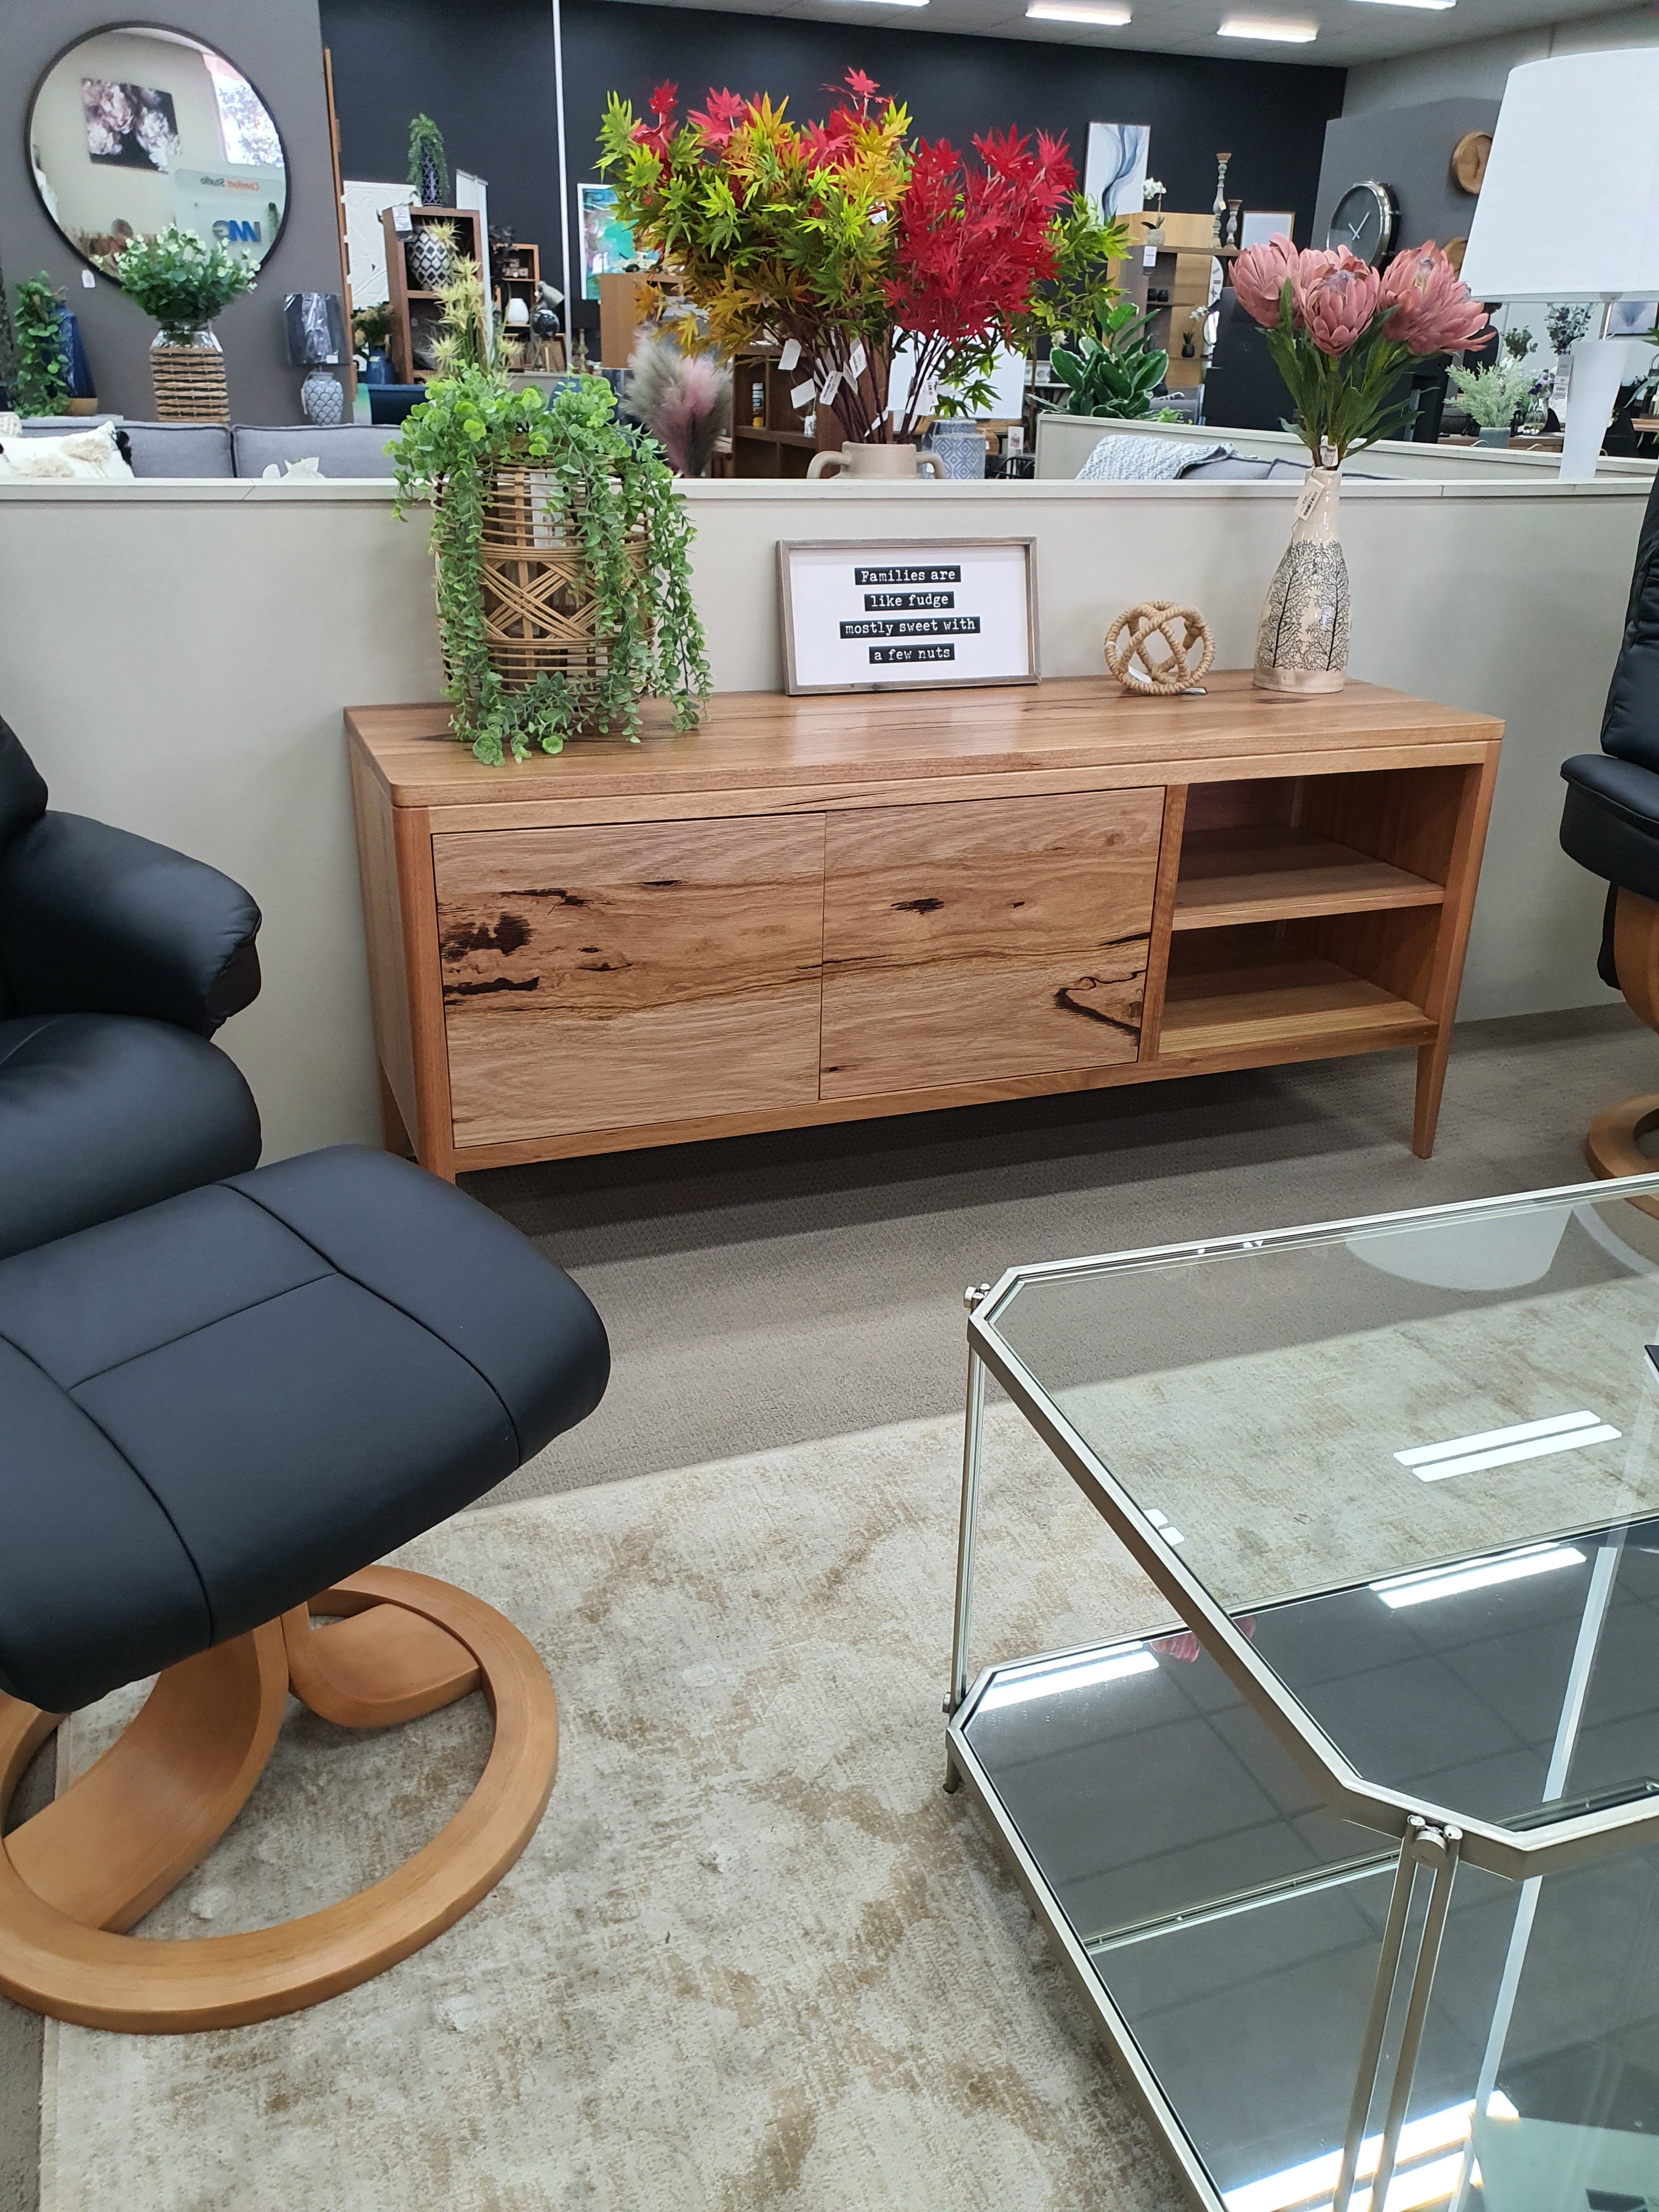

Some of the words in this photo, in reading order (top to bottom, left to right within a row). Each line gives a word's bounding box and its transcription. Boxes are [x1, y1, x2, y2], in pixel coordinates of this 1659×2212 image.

[860, 569, 926, 583] Families
[930, 571, 956, 580] are
[870, 595, 902, 607] like
[909, 593, 949, 608] fudge
[845, 621, 894, 636] mostly
[899, 619, 938, 632] sweet
[943, 618, 975, 630] with
[874, 651, 883, 661] a
[888, 648, 912, 660] few
[918, 646, 950, 658] nuts
